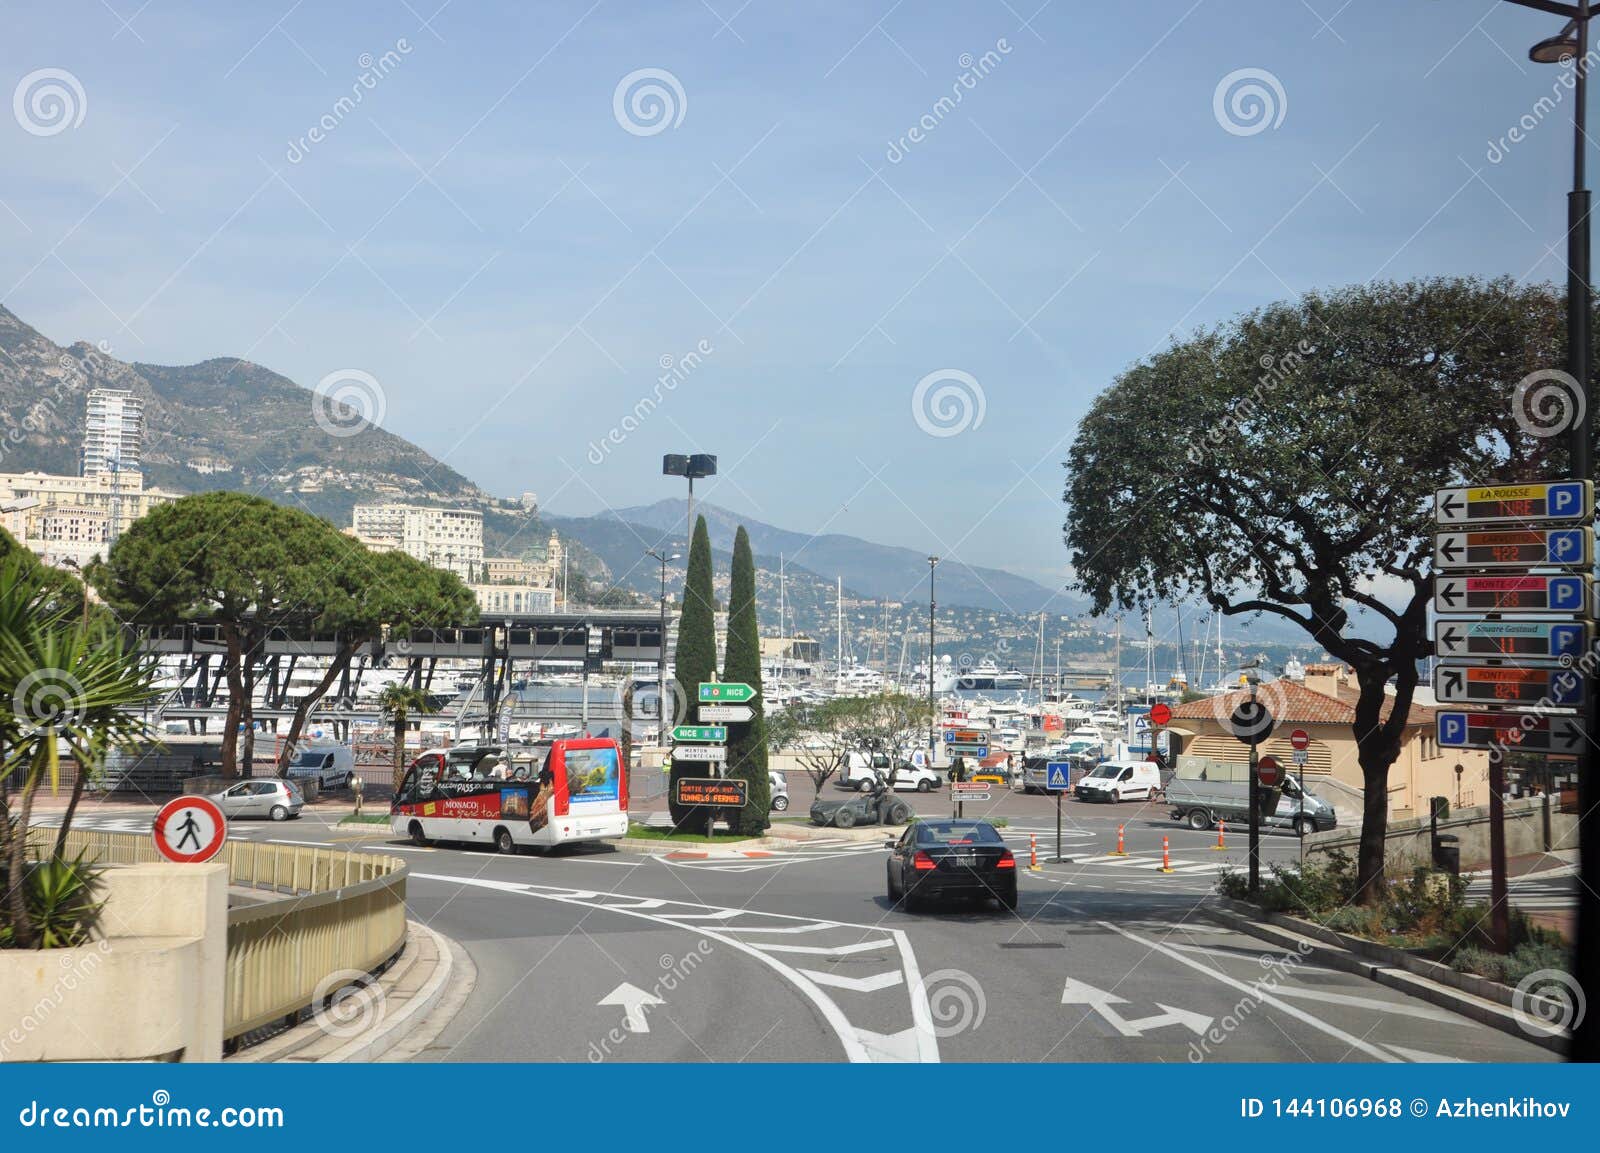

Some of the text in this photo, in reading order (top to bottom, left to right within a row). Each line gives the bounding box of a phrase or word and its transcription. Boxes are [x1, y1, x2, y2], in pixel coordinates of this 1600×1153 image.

[1480, 487, 1530, 499] LA ROUSSE
[1556, 491, 1573, 511] P
[1557, 537, 1573, 557] P
[1557, 584, 1574, 604] P
[1475, 624, 1538, 634] Square Gastaud
[1500, 637, 1515, 653] 11
[1558, 631, 1575, 650] P
[727, 688, 744, 696] NICE
[1495, 683, 1520, 699] 824
[1446, 719, 1459, 739] P
[445, 801, 477, 809] MONACO
[481, 803, 500, 817] tour
